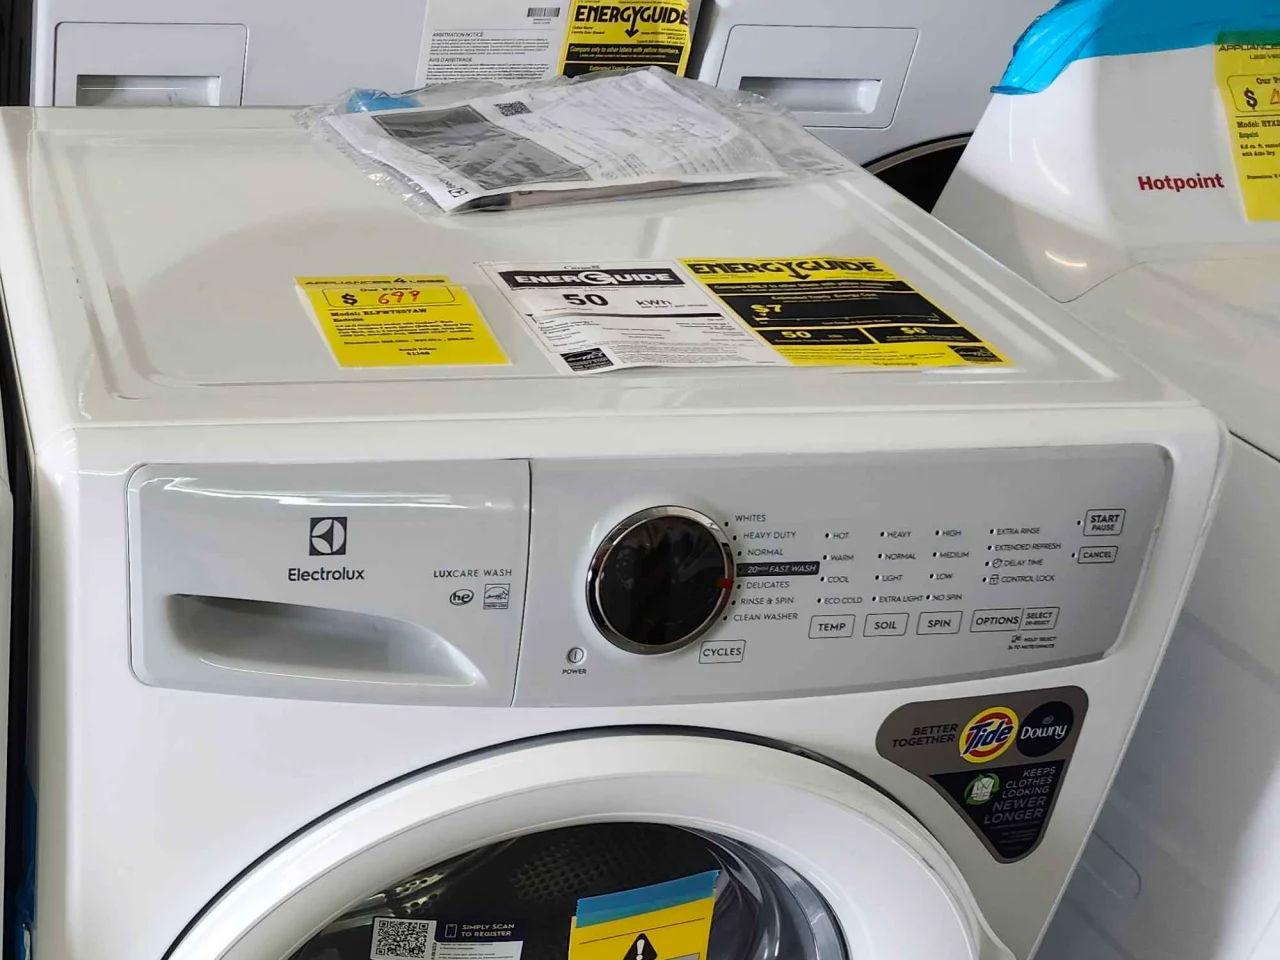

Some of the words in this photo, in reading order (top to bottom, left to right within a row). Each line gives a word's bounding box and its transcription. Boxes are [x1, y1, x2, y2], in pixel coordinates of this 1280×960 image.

[574, 5, 689, 27] ENERGYGUIDE
[1138, 173, 1224, 192] Hotpoint
[686, 260, 884, 276] ENERGYGUIDE
[341, 293, 358, 306] $
[378, 290, 420, 304] 699
[562, 294, 609, 306] 50
[750, 304, 782, 313] $7
[1090, 515, 1120, 523] START
[288, 567, 365, 581] Electrolux
[434, 569, 479, 578] LUXCARE
[483, 569, 512, 577] WASH
[747, 581, 790, 589] DELICATES
[452, 592, 470, 603] he
[928, 620, 951, 628] SPIN
[975, 616, 1019, 625] OPTIONS
[818, 623, 846, 631] TEMP
[702, 648, 742, 656] CYCLES
[912, 724, 958, 735] BETTER
[1020, 723, 1068, 740] Downy
[892, 734, 955, 748] TOGETHER
[960, 718, 1014, 756] Tide
[1023, 767, 1056, 777] KEEPS
[1006, 776, 1052, 789] CLOTHES
[1002, 786, 1049, 798] LOOKING
[992, 796, 1046, 812] NEWER
[984, 808, 1044, 824] LONGER
